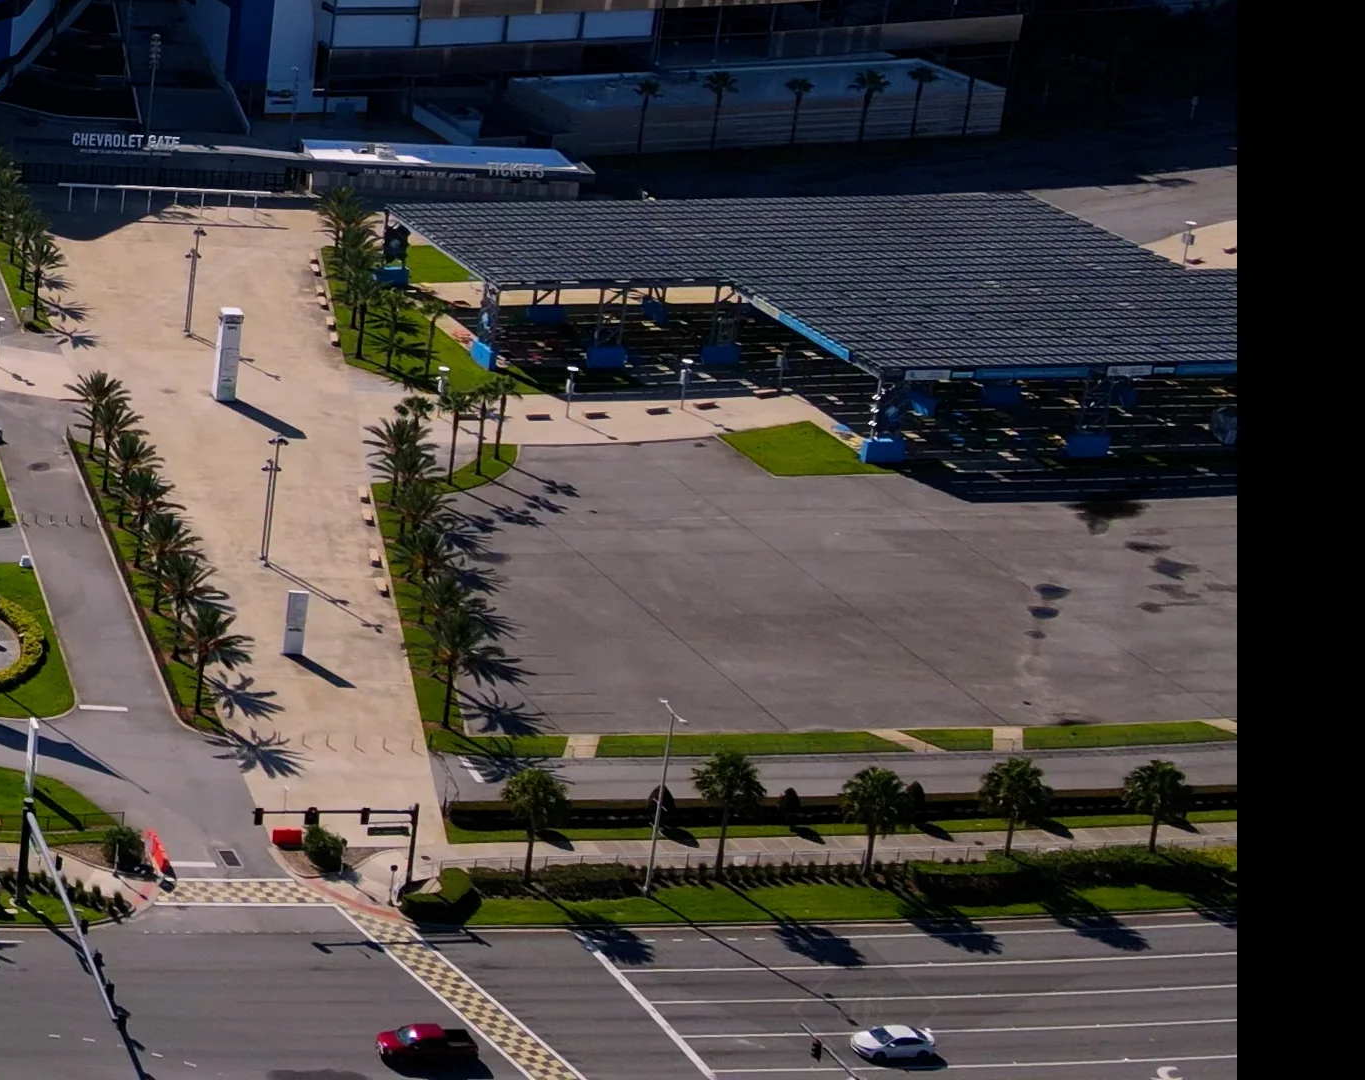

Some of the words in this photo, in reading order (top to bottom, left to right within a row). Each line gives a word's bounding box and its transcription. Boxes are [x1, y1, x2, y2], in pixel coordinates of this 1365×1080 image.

[71, 131, 145, 148] CHEVROLET
[146, 133, 181, 151] GATE
[486, 162, 545, 178] TICKETS
